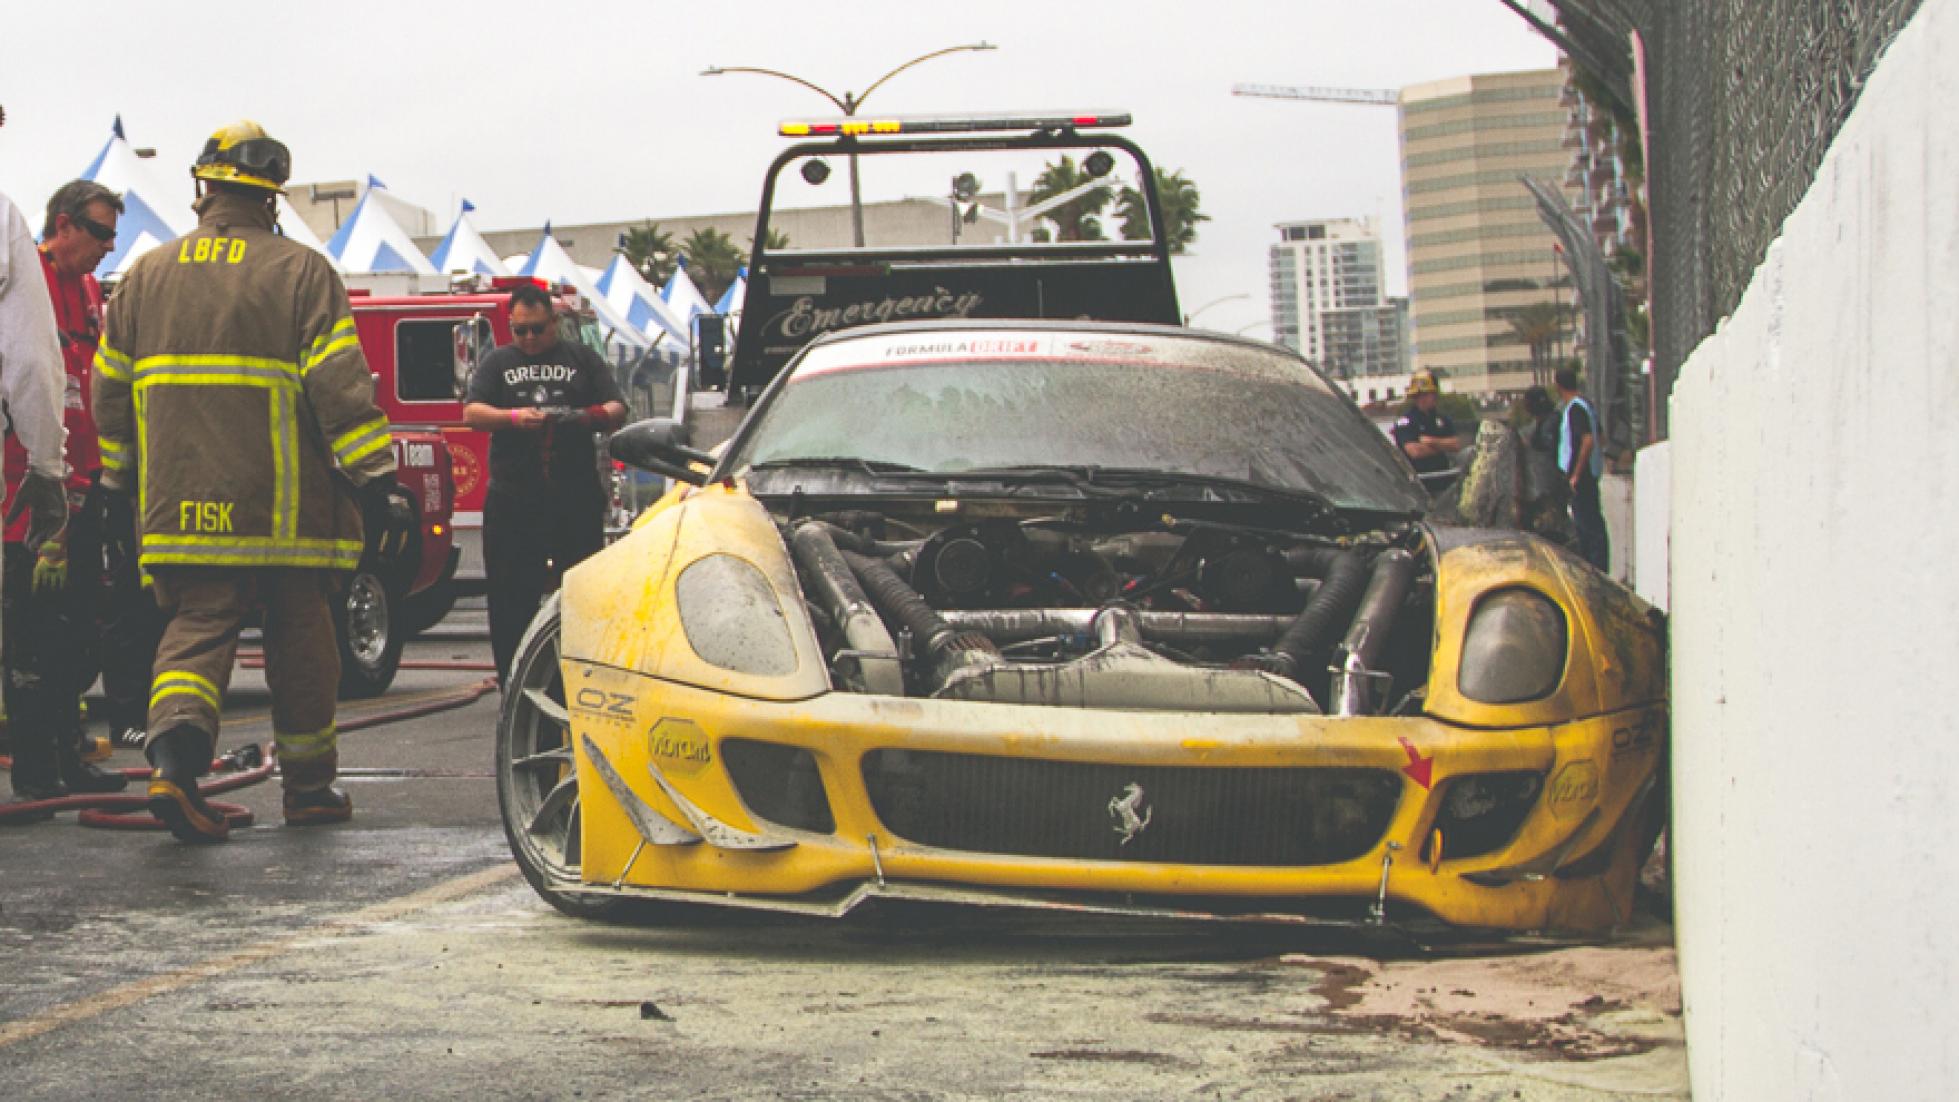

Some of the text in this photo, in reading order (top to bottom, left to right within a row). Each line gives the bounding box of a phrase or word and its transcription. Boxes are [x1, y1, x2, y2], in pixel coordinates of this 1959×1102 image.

[178, 237, 247, 264] LBFD
[762, 284, 983, 337] Emergency
[503, 364, 577, 386] GREDDY
[180, 500, 235, 532] FISK
